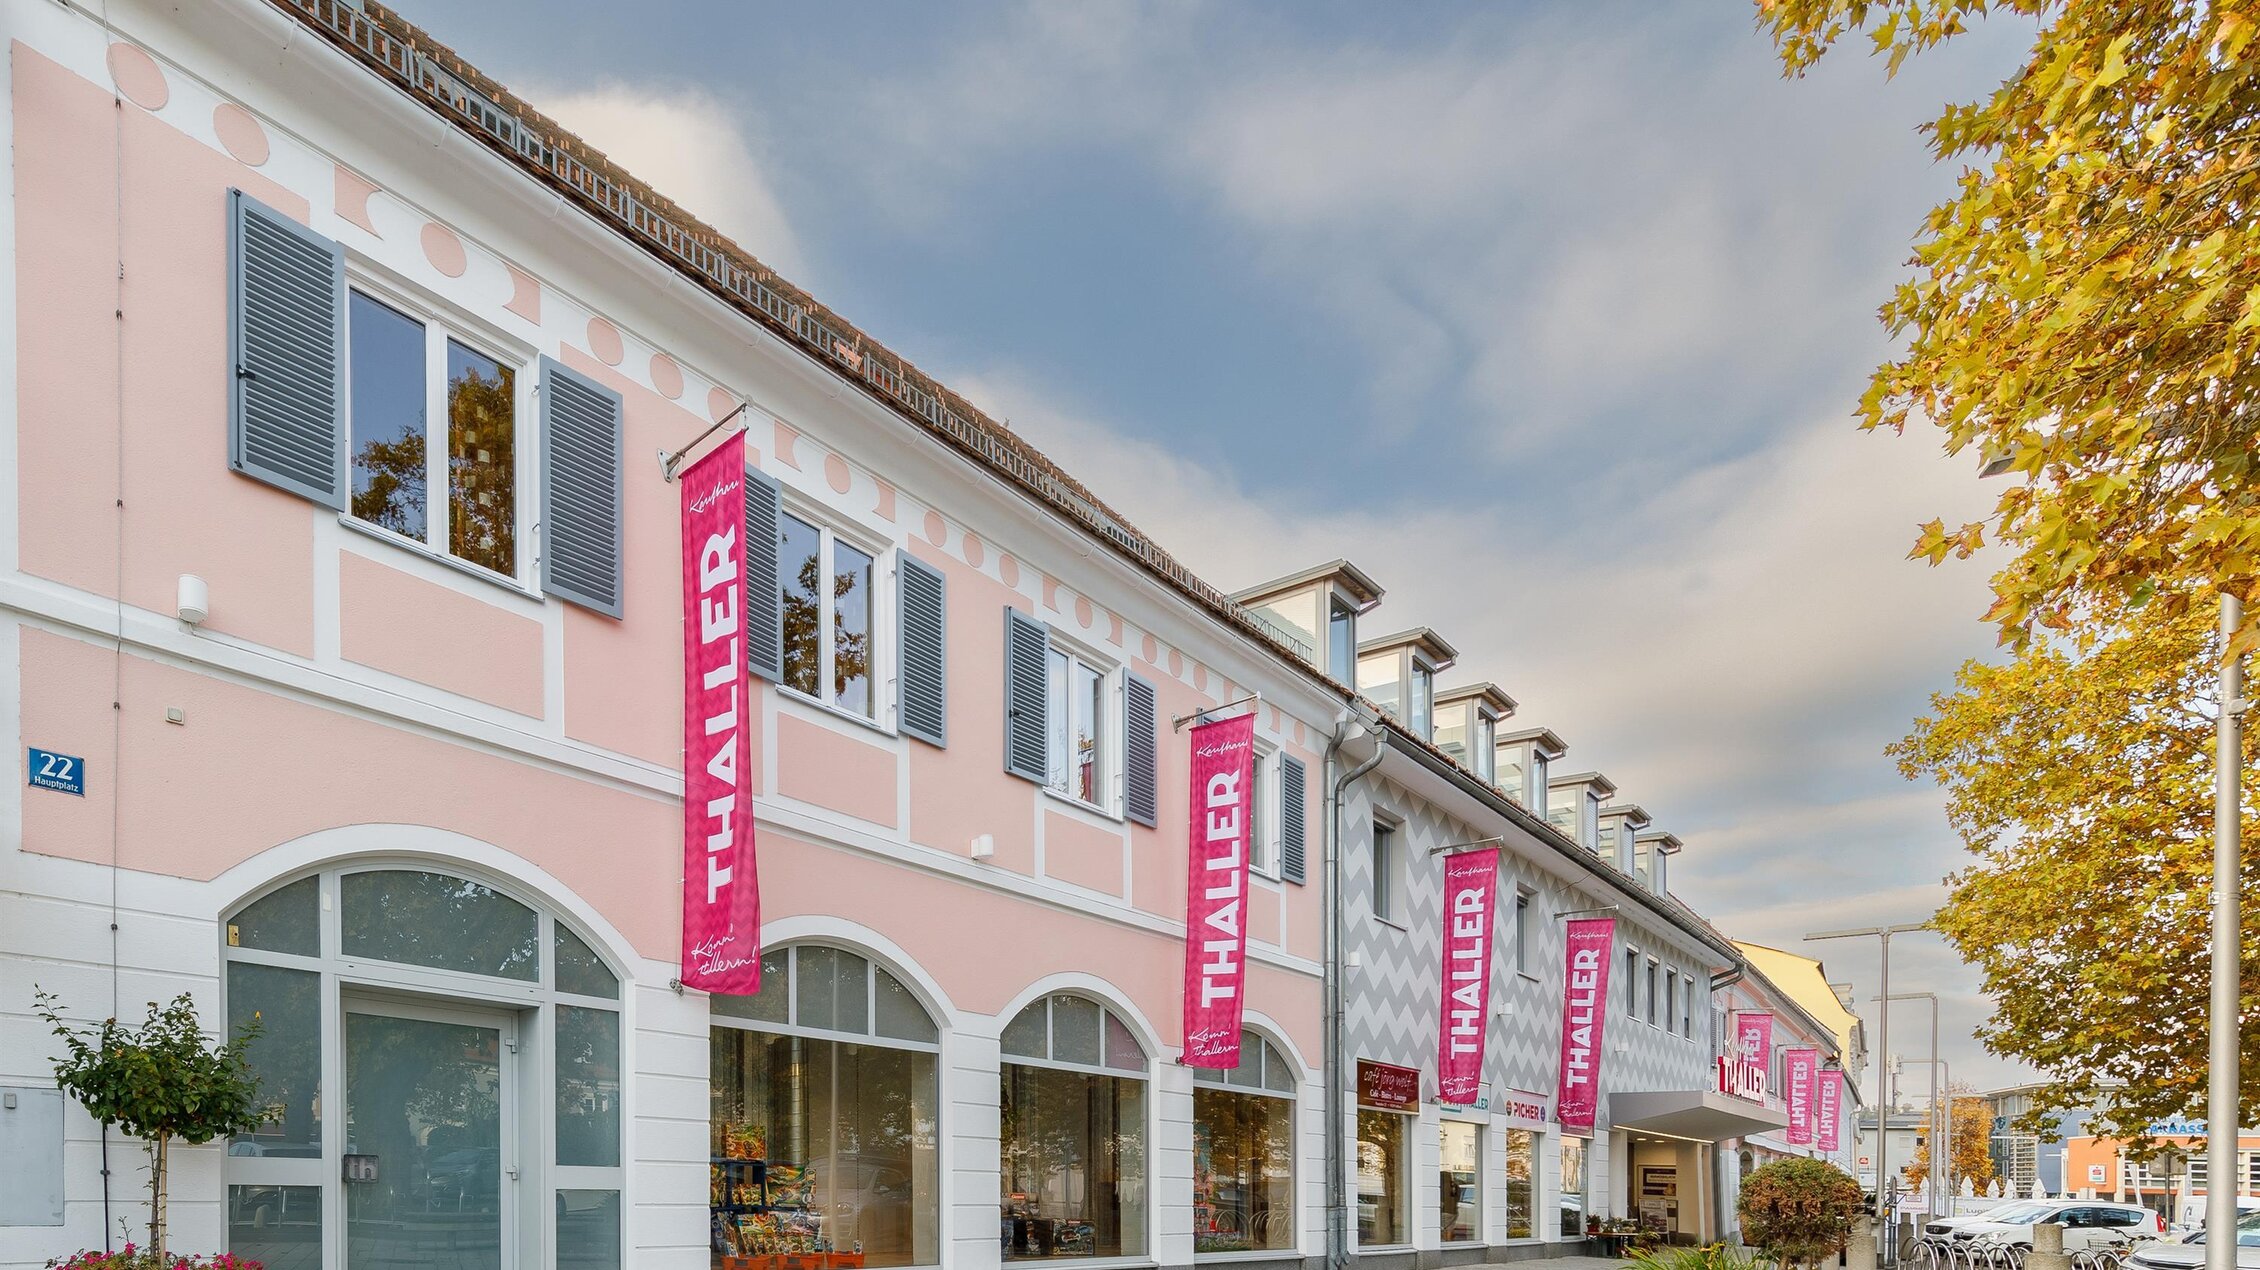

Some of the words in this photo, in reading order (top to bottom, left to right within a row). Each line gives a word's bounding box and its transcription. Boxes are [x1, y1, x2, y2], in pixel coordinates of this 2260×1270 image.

[700, 523, 740, 905] THALLER
[34, 775, 79, 792] Hauptplatz
[40, 753, 74, 781] 22
[1201, 768, 1241, 1009] THALLER
[1450, 886, 1486, 1060] THALLER
[1566, 948, 1600, 1089] THALLER
[1513, 1101, 1540, 1121] PICHER
[1718, 1056, 1766, 1103] THALLER
